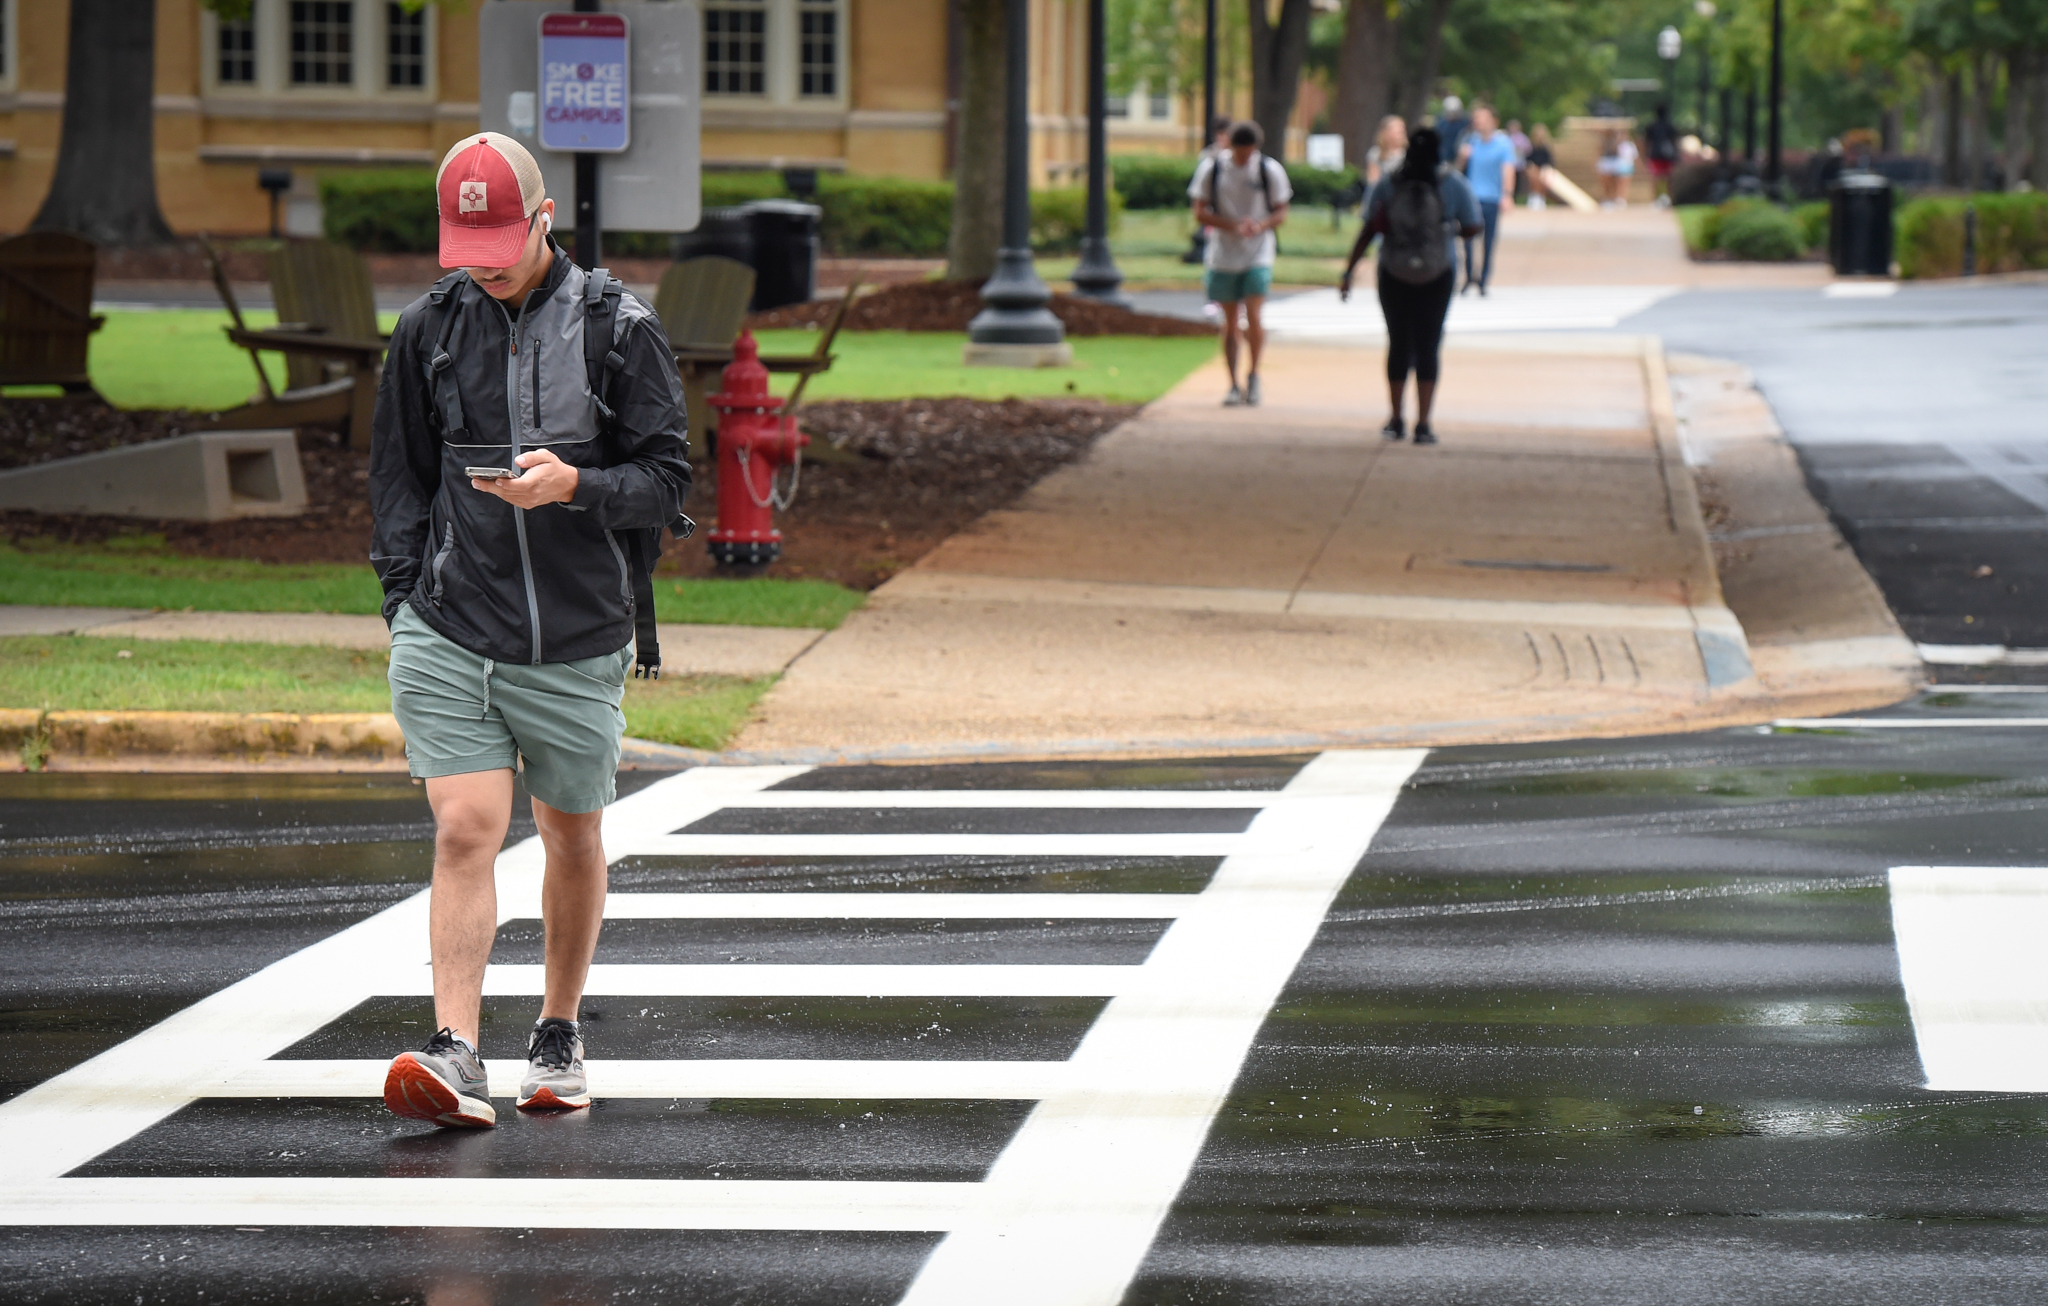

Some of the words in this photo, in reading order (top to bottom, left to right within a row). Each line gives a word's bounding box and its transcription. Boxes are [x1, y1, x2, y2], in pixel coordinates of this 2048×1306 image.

[546, 62, 623, 81] SMOKE
[546, 82, 623, 107] FREE
[546, 106, 623, 124] CAMPUS
